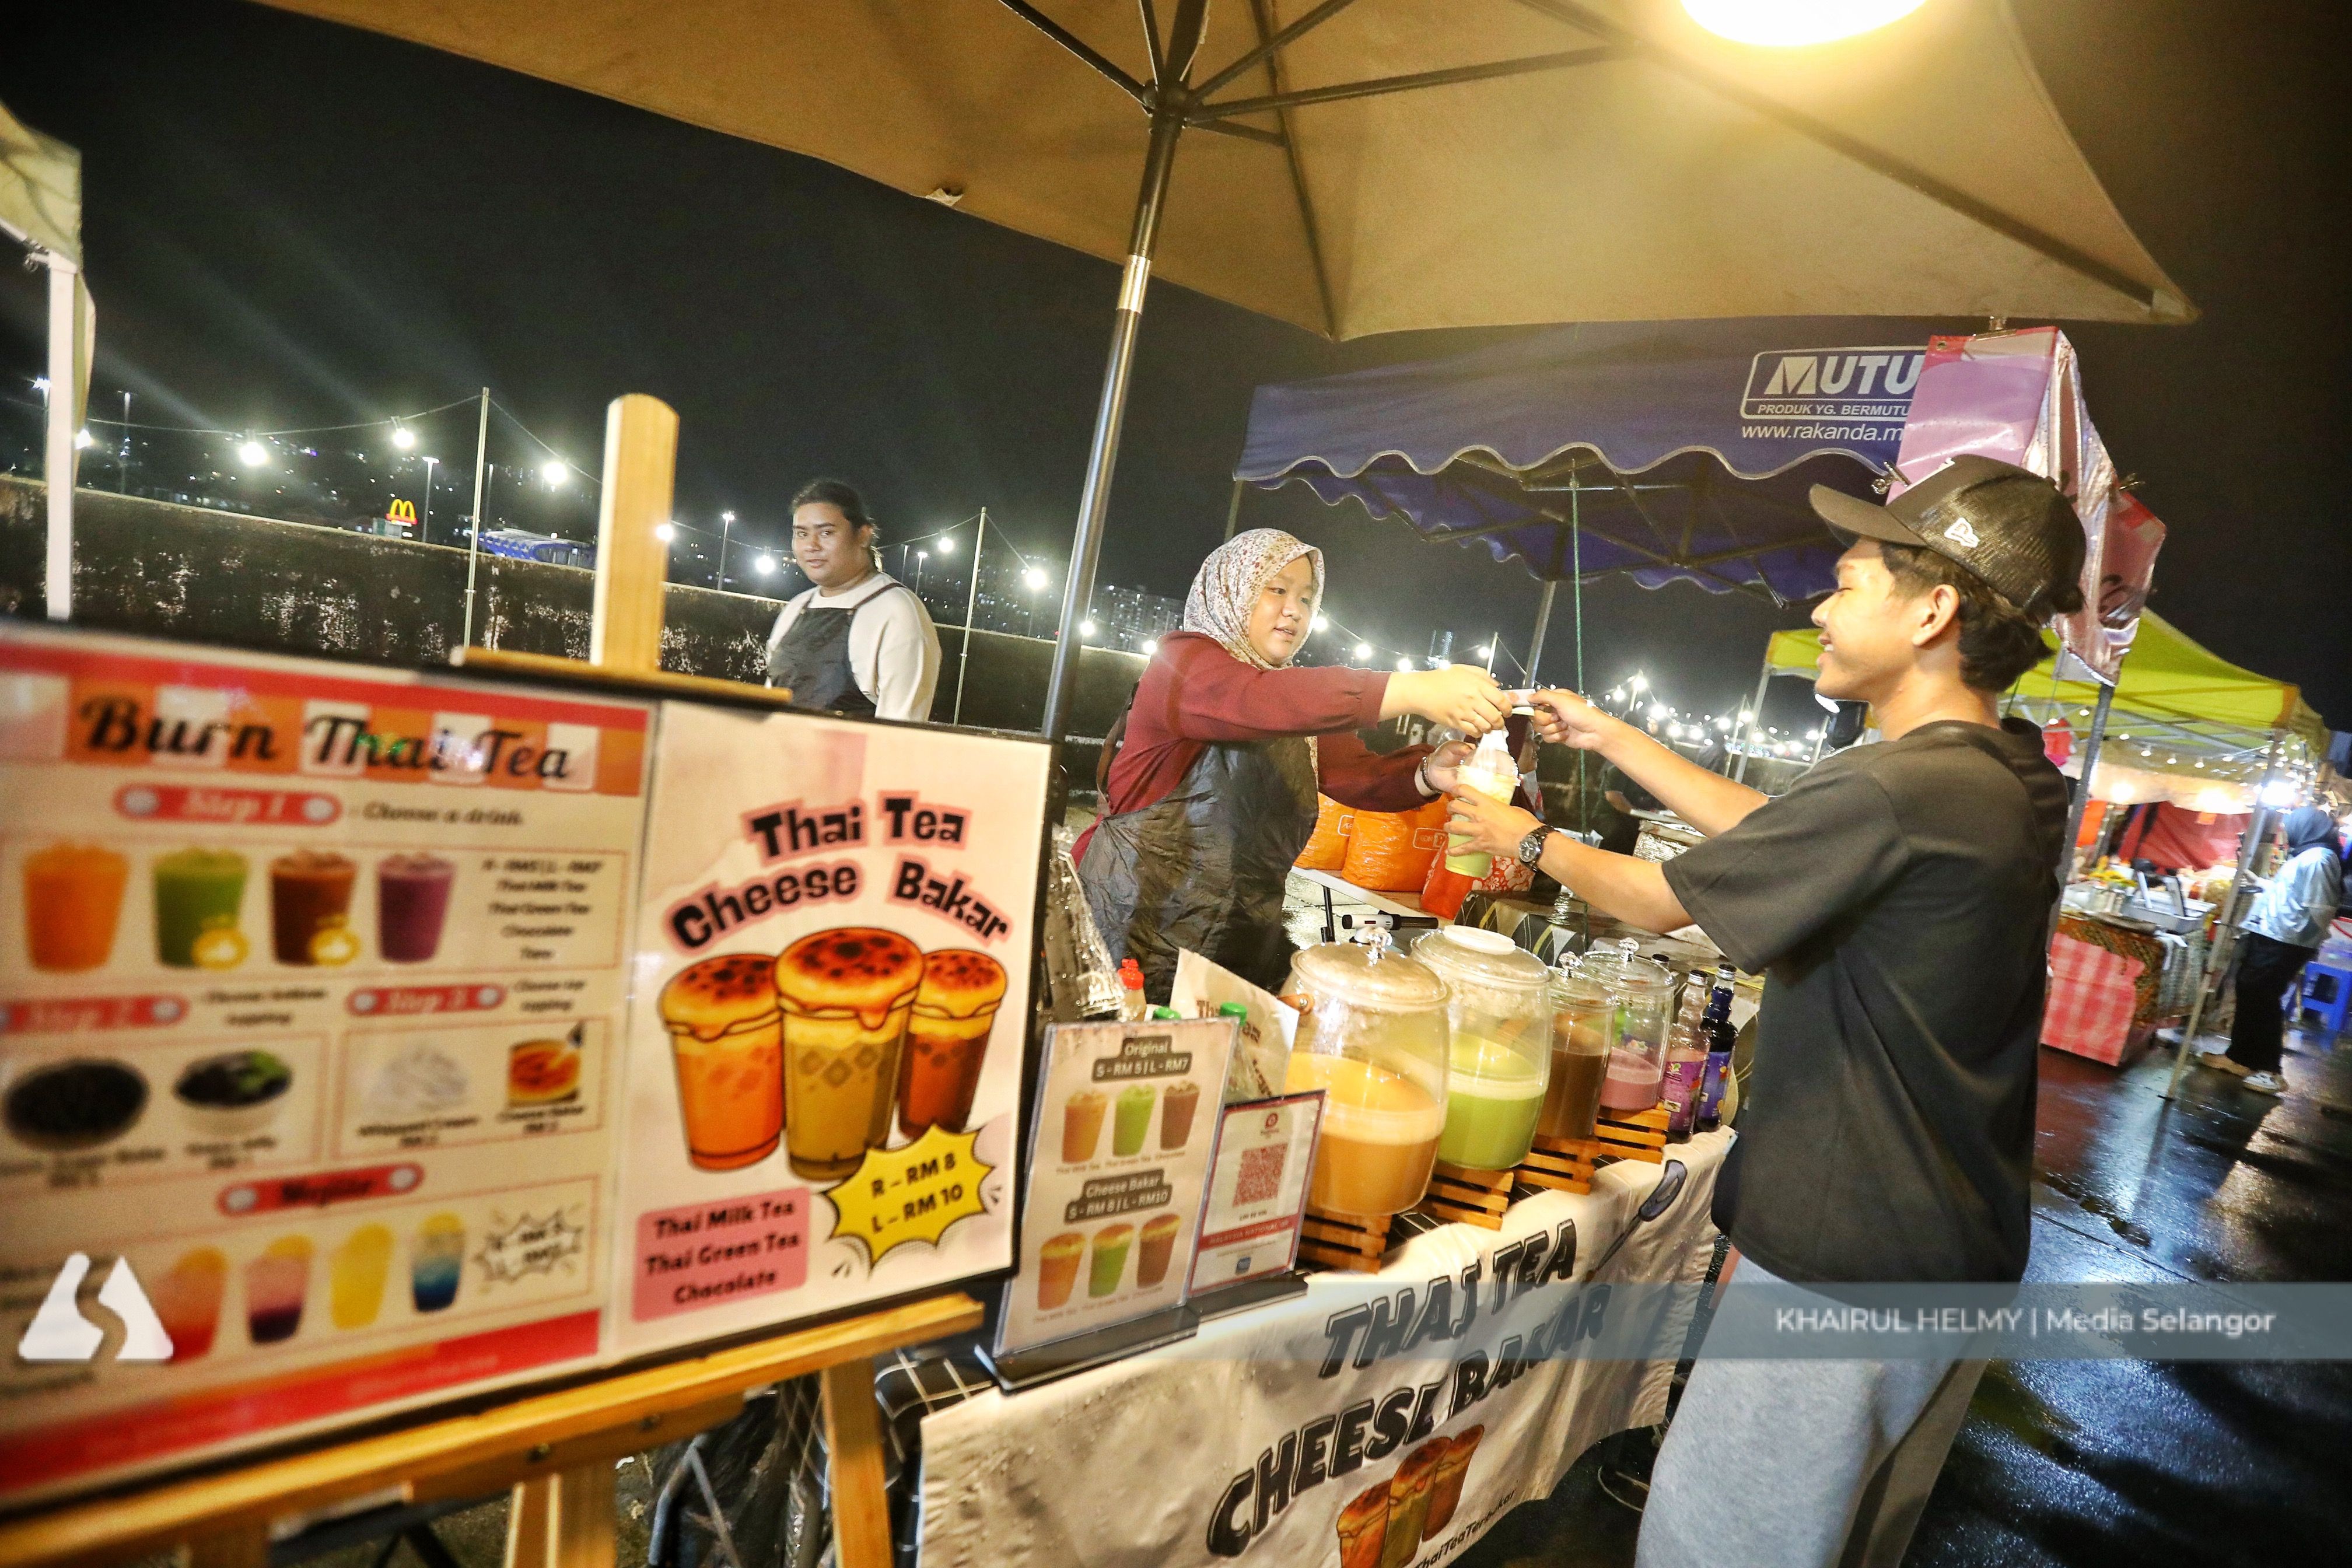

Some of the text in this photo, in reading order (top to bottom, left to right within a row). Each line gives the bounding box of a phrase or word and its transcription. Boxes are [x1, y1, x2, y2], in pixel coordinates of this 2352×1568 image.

[1764, 355, 1925, 395] MUTU
[1757, 404, 1909, 416] PRODUK YG. BERMUTU
[77, 694, 572, 780] Burn Thai Tea
[753, 798, 964, 858] Thai Tea
[671, 860, 1008, 949] Cheese Bakar
[1113, 1062, 1133, 1076] RM
[1125, 1041, 1168, 1058] Original
[872, 1179, 885, 1198] R
[907, 1158, 939, 1186] RM
[1086, 1176, 1160, 1198] Cheese Bakar
[654, 1200, 794, 1240] Thai Milk Tea
[871, 1215, 883, 1234] L
[904, 1194, 937, 1222] RM
[940, 1184, 963, 1206] 10
[1087, 1202, 1105, 1216] RM
[644, 1232, 799, 1276] Thai Green Tea
[674, 1272, 776, 1304] Chocolate
[1318, 1219, 1576, 1378] THAI TEA
[1206, 1284, 1612, 1558] CHEESE BAKAR
